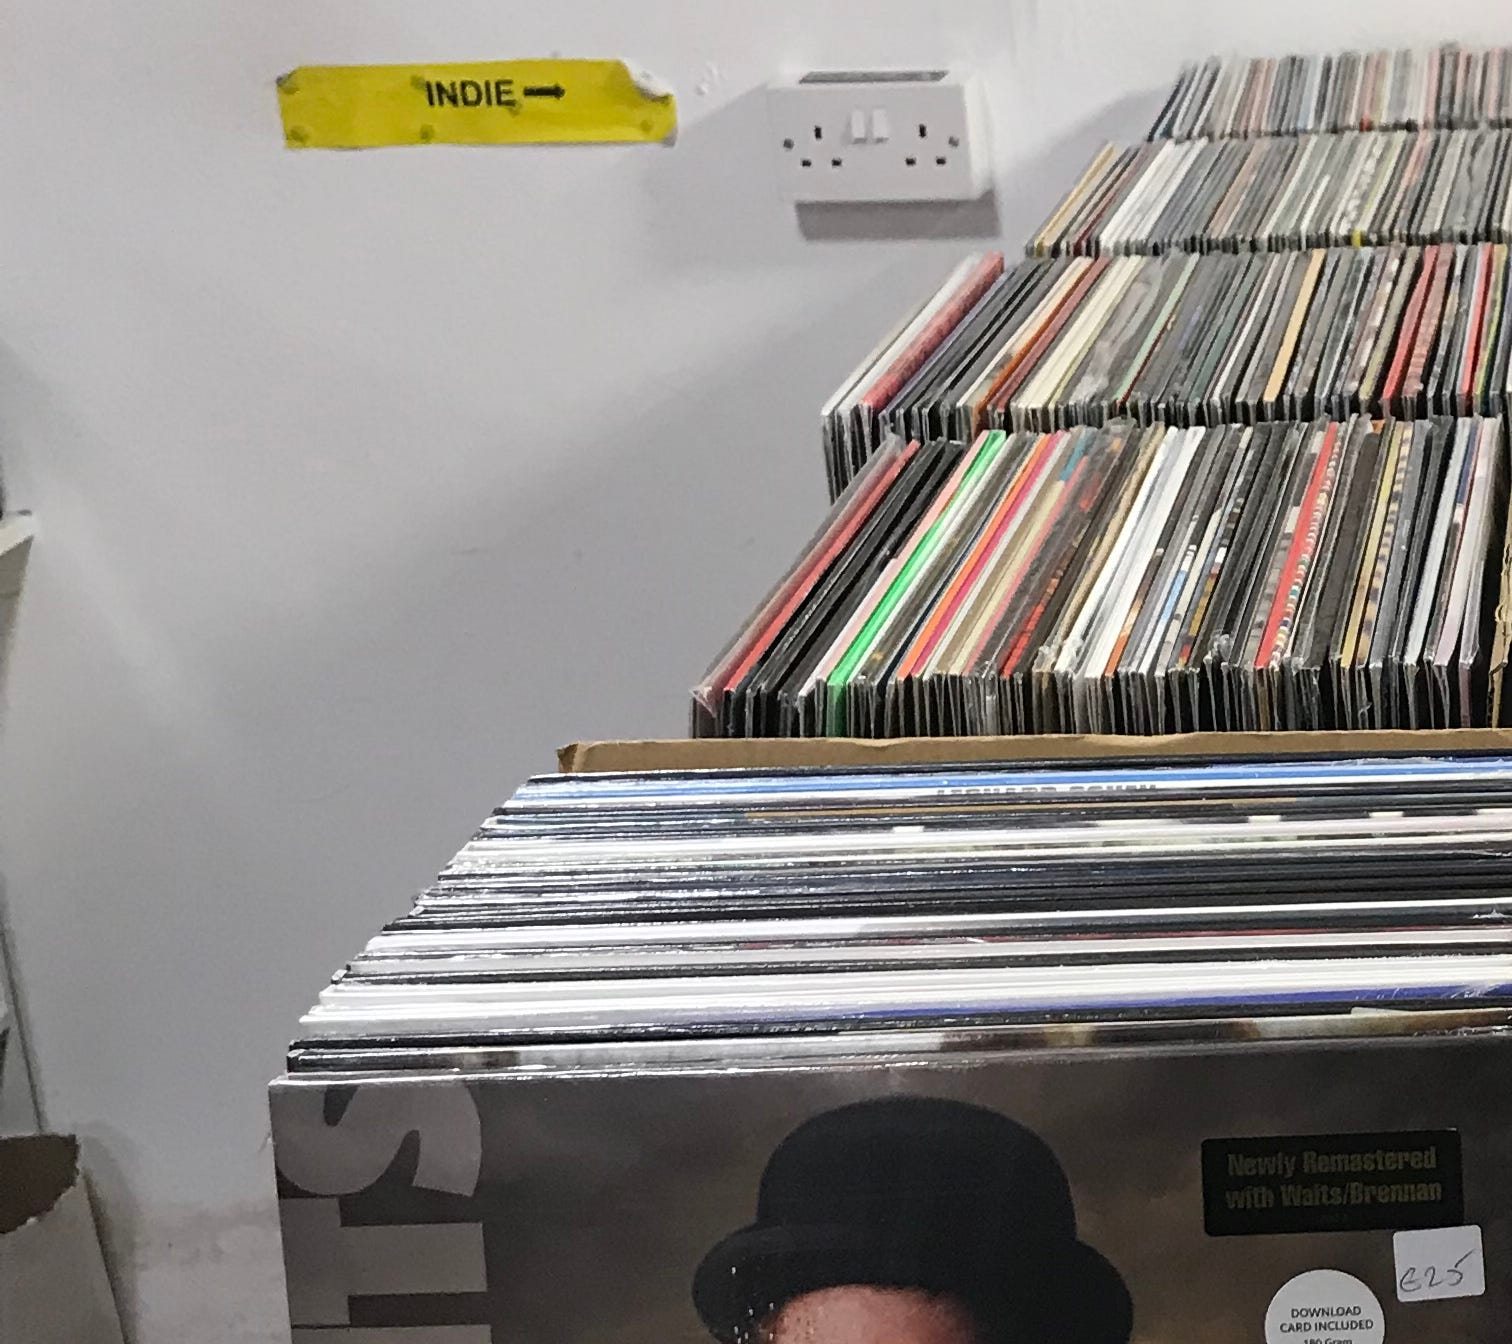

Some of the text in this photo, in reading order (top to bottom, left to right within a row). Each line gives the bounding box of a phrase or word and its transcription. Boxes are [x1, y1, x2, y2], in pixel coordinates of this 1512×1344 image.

[425, 78, 518, 108] INDIE
[1228, 1147, 1437, 1179] Newly Remastered
[1226, 1186, 1273, 1209] with
[1290, 1305, 1362, 1320] DOWNLOAD
[1279, 1319, 1374, 1334] CARD INCLUDED
